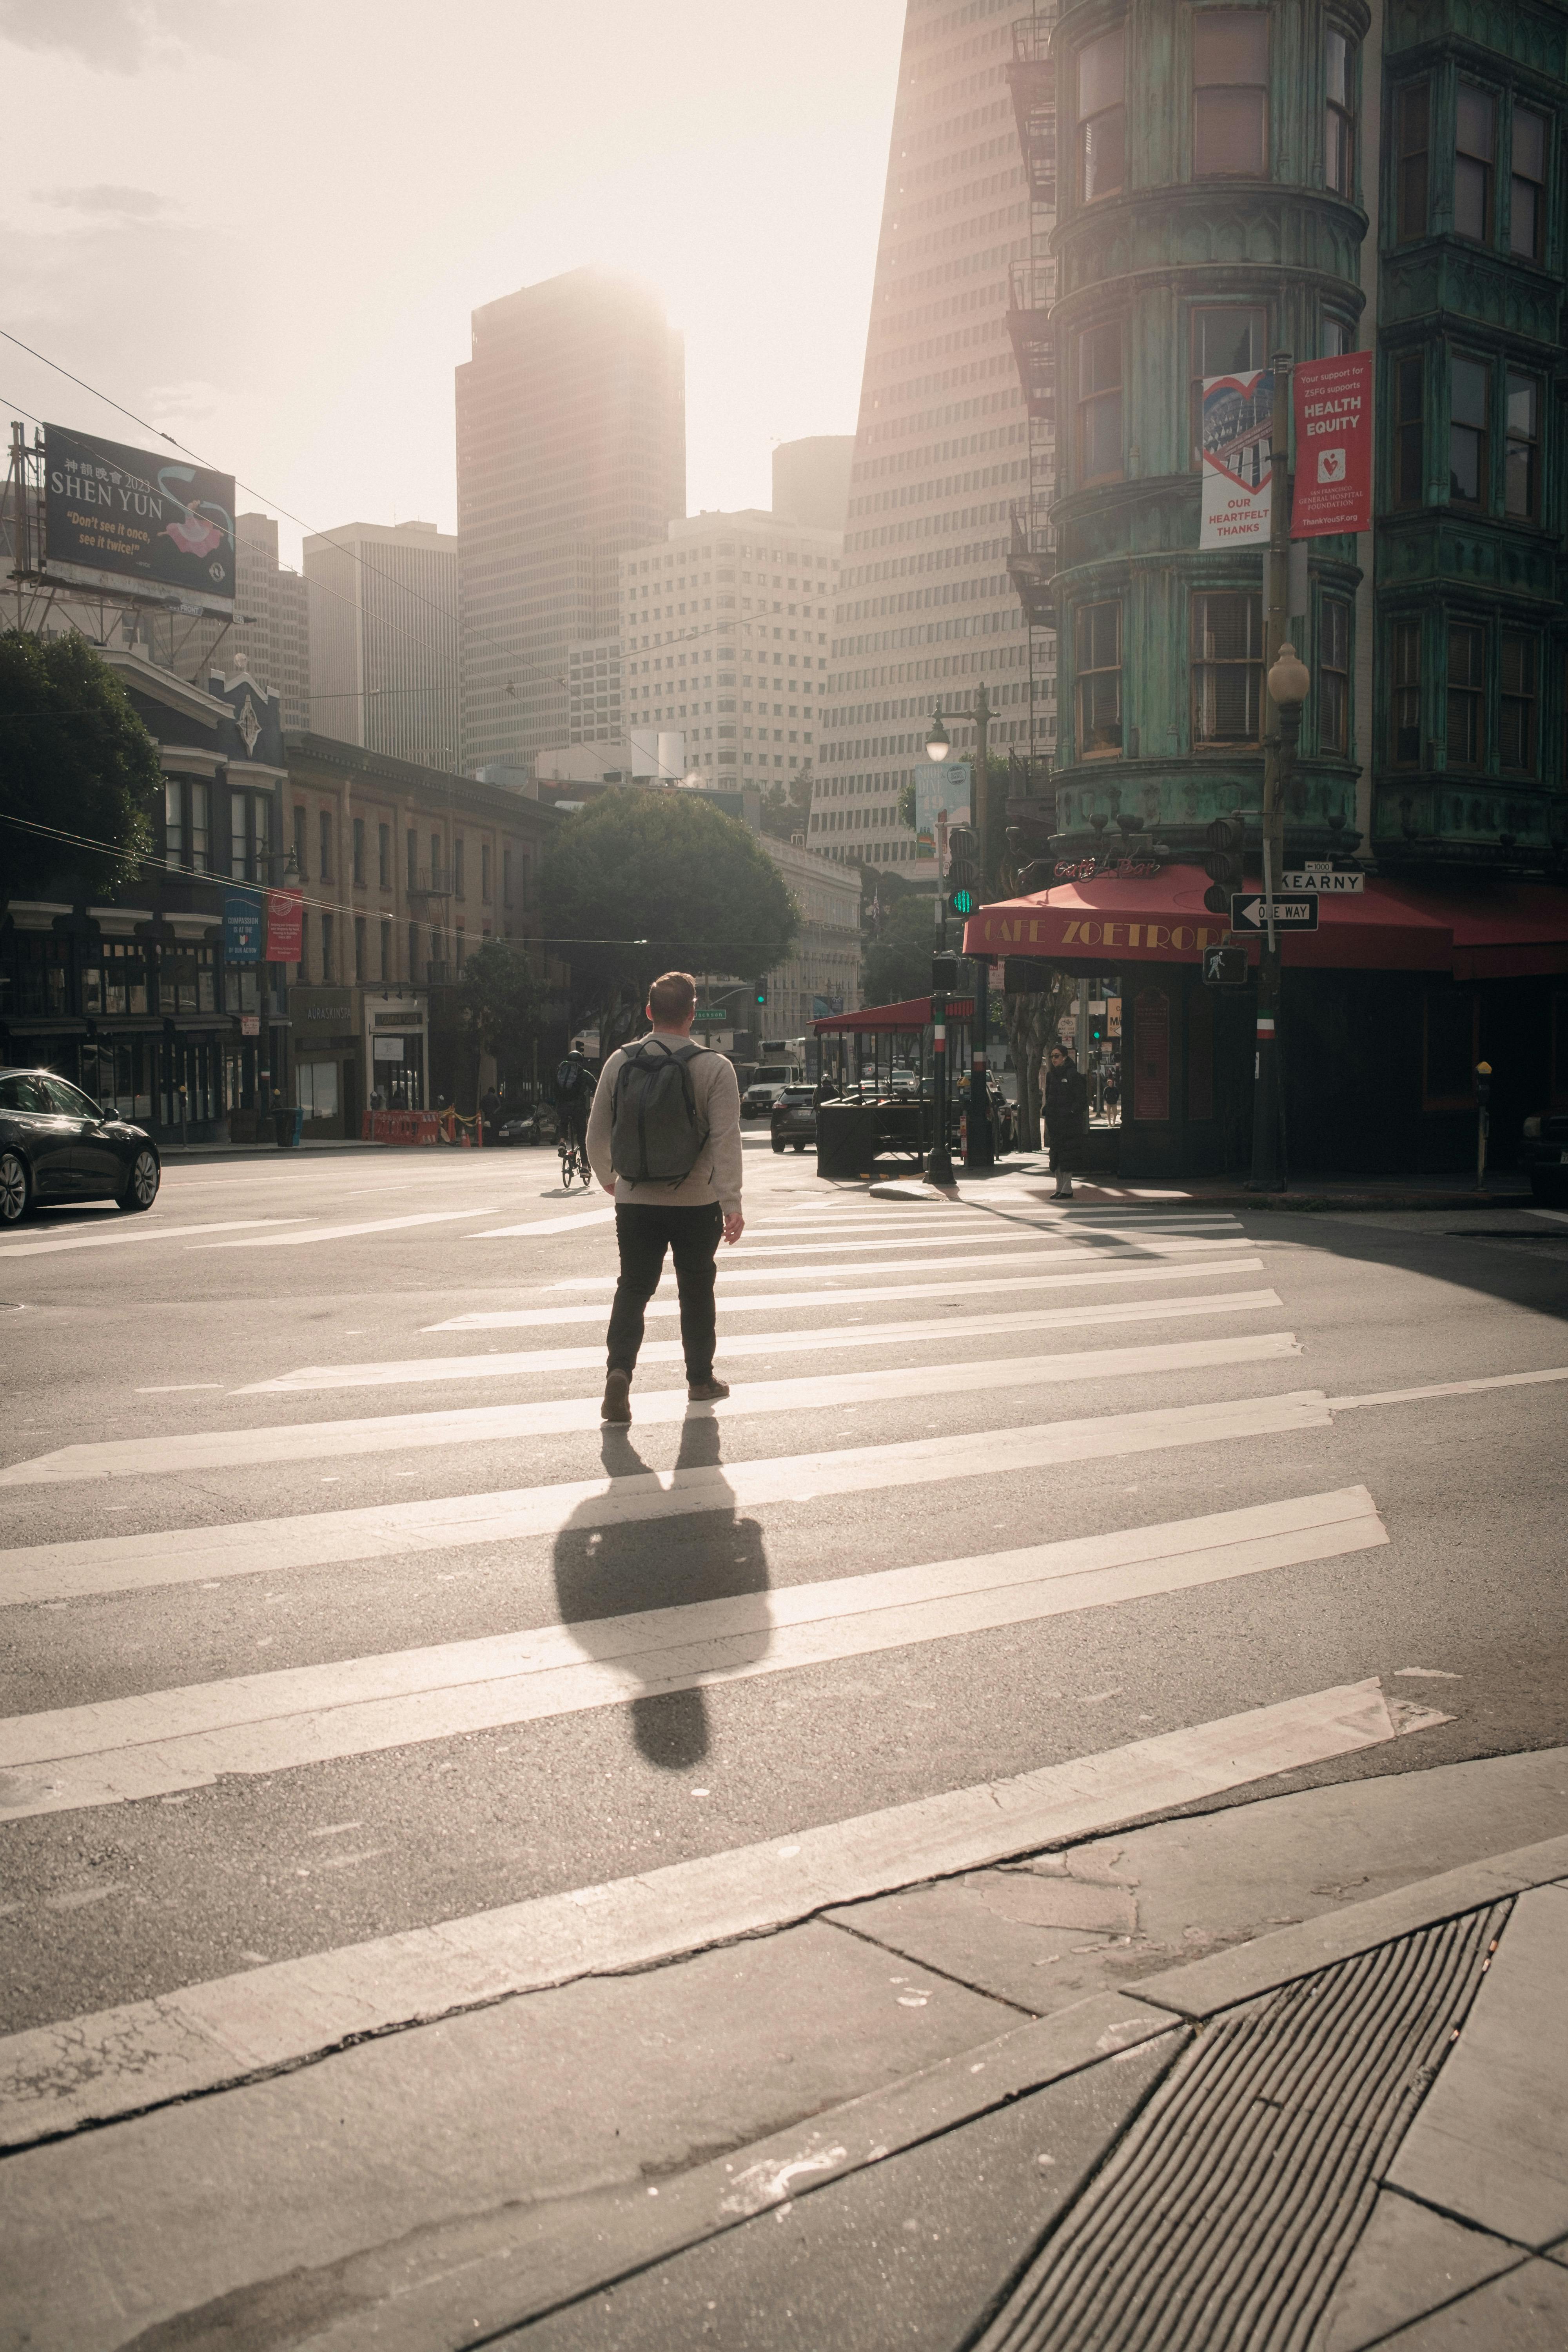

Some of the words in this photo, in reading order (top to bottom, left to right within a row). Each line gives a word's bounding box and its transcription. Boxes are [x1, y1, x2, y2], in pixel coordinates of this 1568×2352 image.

[1320, 369, 1350, 381] support
[1305, 387, 1325, 397] ZSFG
[1327, 382, 1360, 393] supports
[1304, 396, 1361, 418] HEALTH
[1307, 415, 1359, 436] EQUITY
[64, 458, 123, 485] 神韻晚會
[125, 475, 150, 494] 2023
[1321, 486, 1352, 494] FRANCISCO
[51, 472, 112, 507] SHEN
[118, 488, 163, 521] YUN
[1227, 498, 1250, 508] OUR
[1299, 495, 1328, 505] GENERAL
[1330, 491, 1363, 501] HOSPITAL
[1308, 499, 1354, 510] FOUNDATION
[1209, 509, 1269, 524] HEARTFELT
[1302, 515, 1358, 526] ThankYouSF.org
[100, 521, 115, 532] see
[117, 523, 125, 536] it
[127, 528, 151, 544] once,
[1217, 523, 1259, 536] THANKS
[79, 533, 95, 546] see
[97, 535, 105, 548] it
[918, 766, 942, 779] SHOP
[919, 779, 942, 794] DINE
[1118, 858, 1160, 875] Bar
[1282, 875, 1359, 889] KEARNY
[1258, 906, 1280, 918] OE
[1285, 906, 1307, 918] WAY
[984, 919, 1046, 942] CAFE
